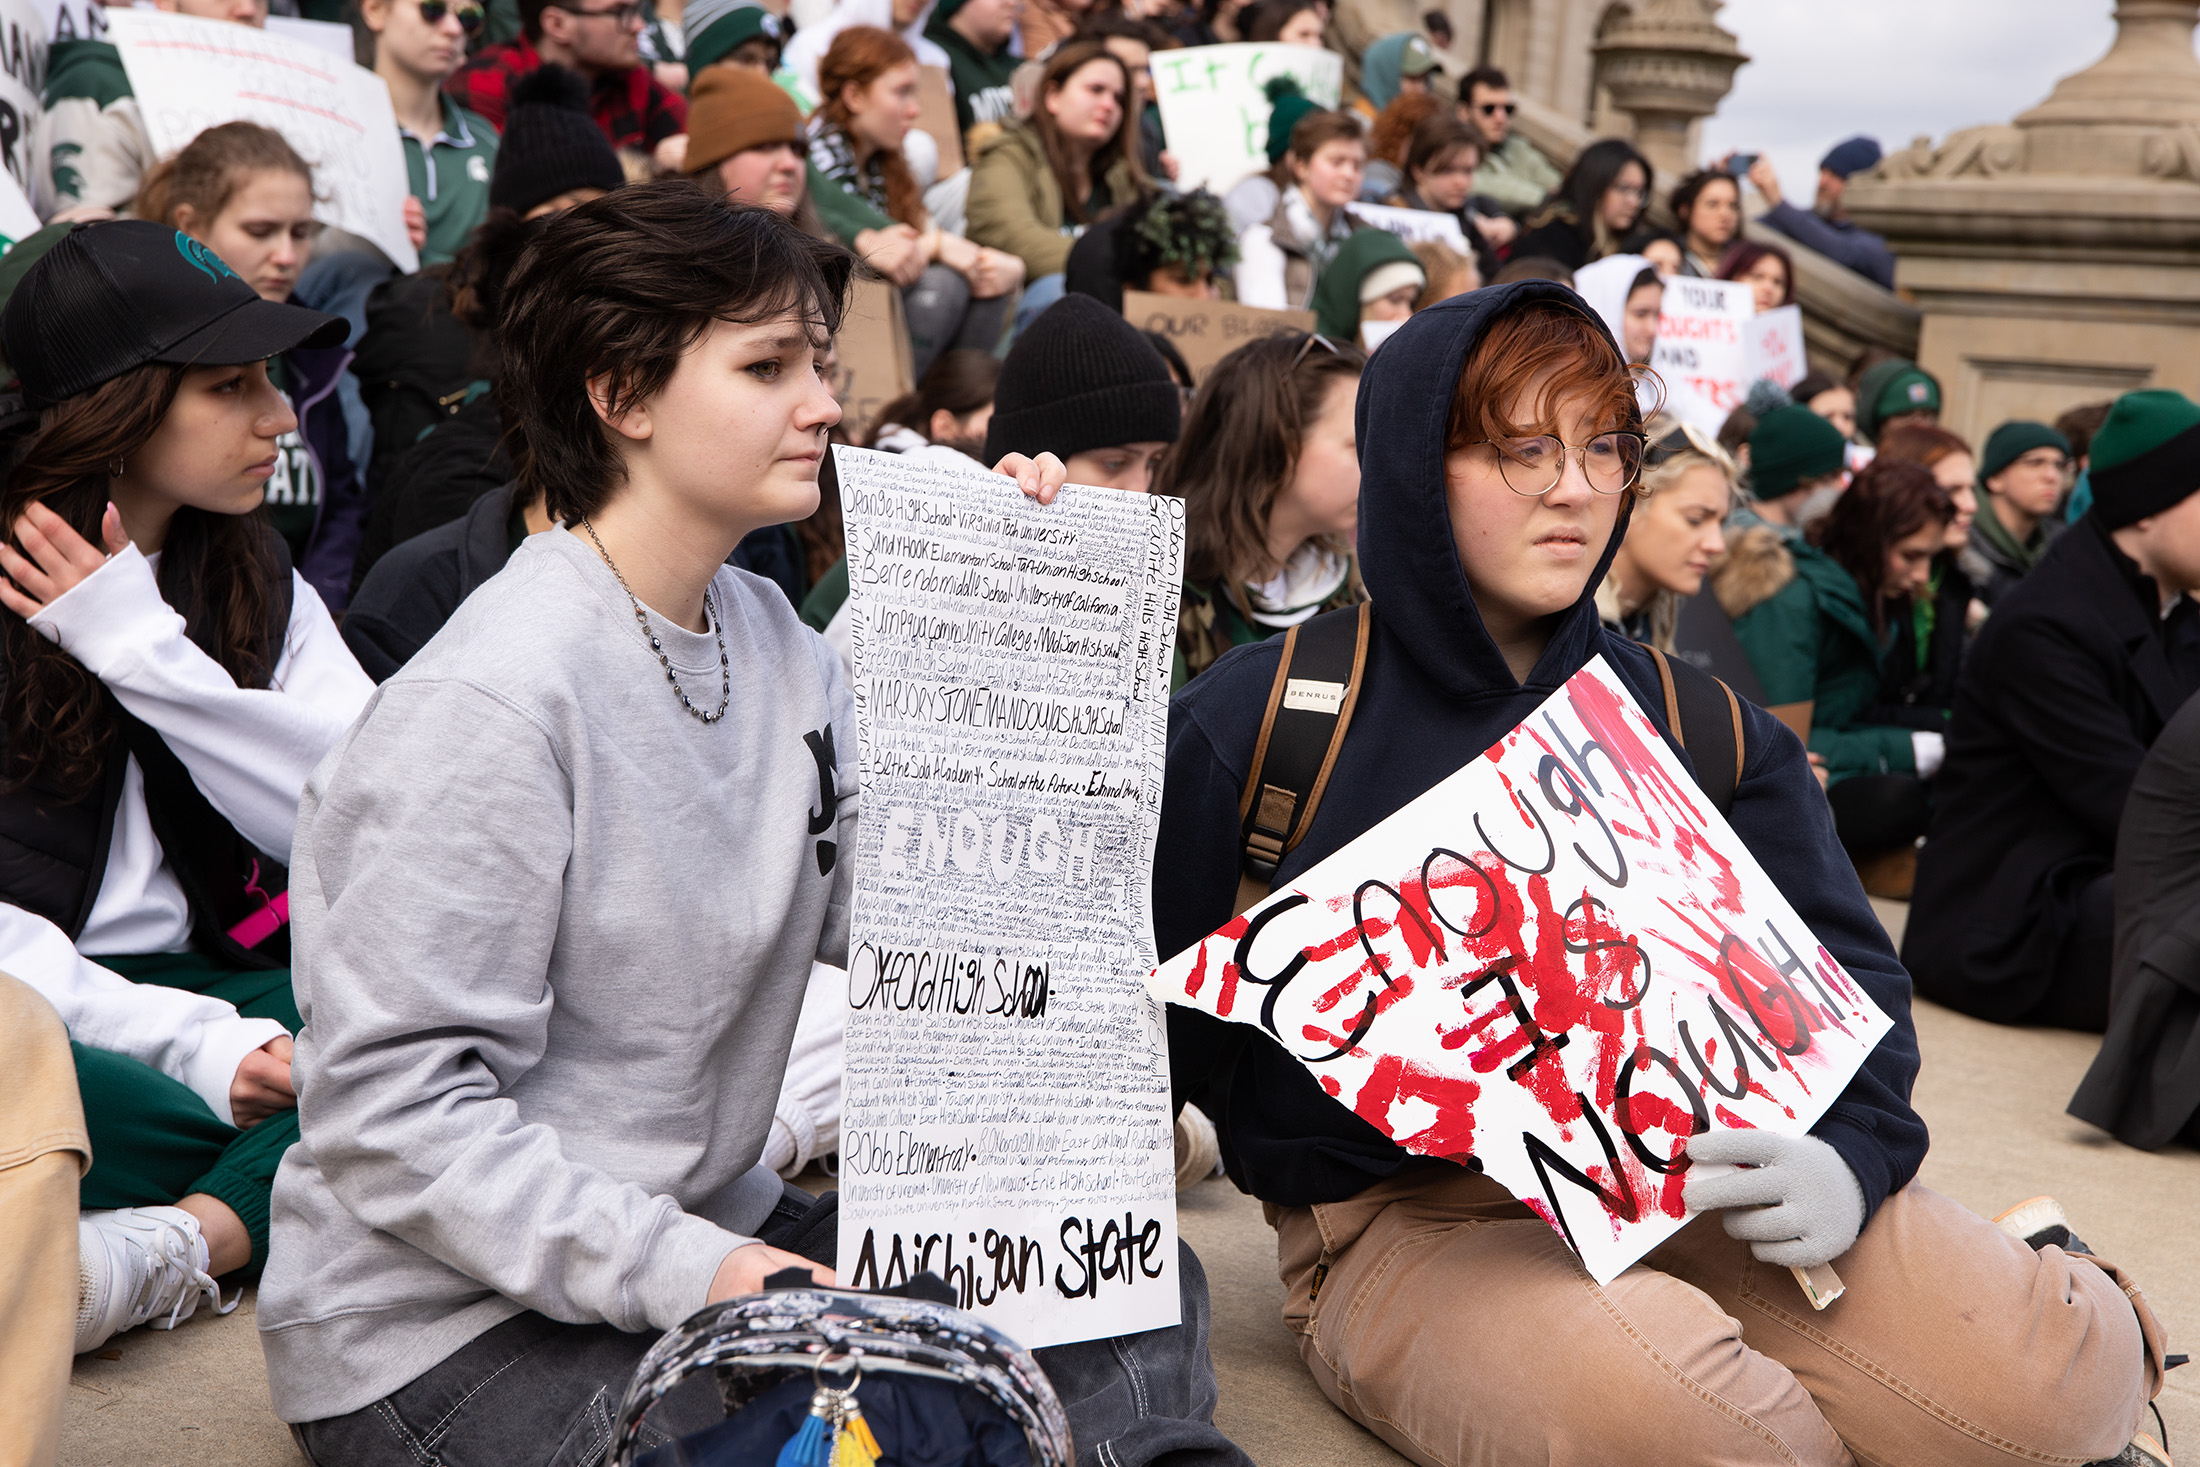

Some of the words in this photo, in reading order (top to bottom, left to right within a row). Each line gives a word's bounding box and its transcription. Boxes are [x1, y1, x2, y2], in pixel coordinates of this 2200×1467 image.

[1145, 311, 1210, 337] OUR
[1090, 567, 1126, 588] School
[1290, 690, 1336, 701] BENRUS
[851, 1226, 1044, 1311] Michigan
[1054, 1210, 1164, 1299] State
